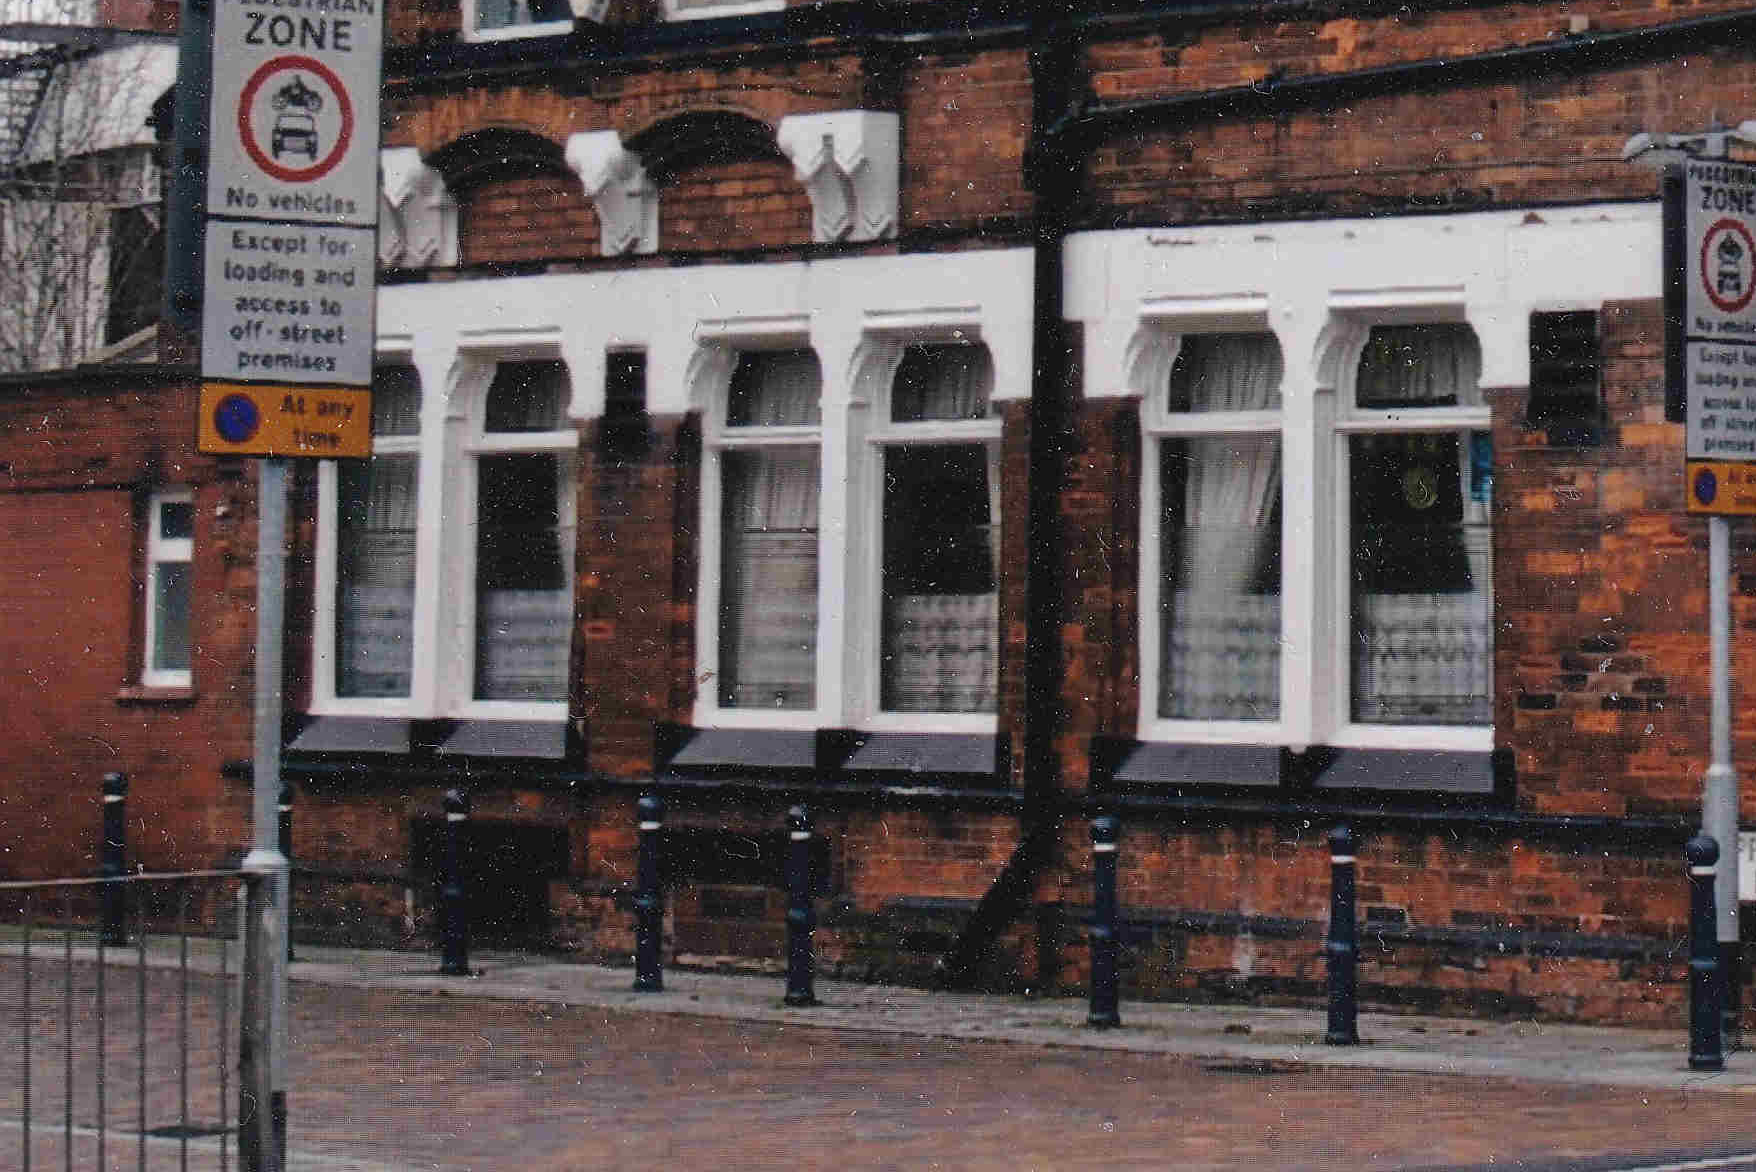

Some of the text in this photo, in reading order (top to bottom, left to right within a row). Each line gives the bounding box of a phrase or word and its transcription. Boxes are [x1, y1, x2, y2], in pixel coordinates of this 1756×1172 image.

[246, 12, 352, 52] ZONE
[226, 188, 356, 214] No vehicles
[1701, 186, 1756, 215] ZONE
[232, 229, 350, 256] Except for
[224, 258, 356, 287] loading and
[235, 296, 342, 316] access to
[237, 351, 337, 373] premises
